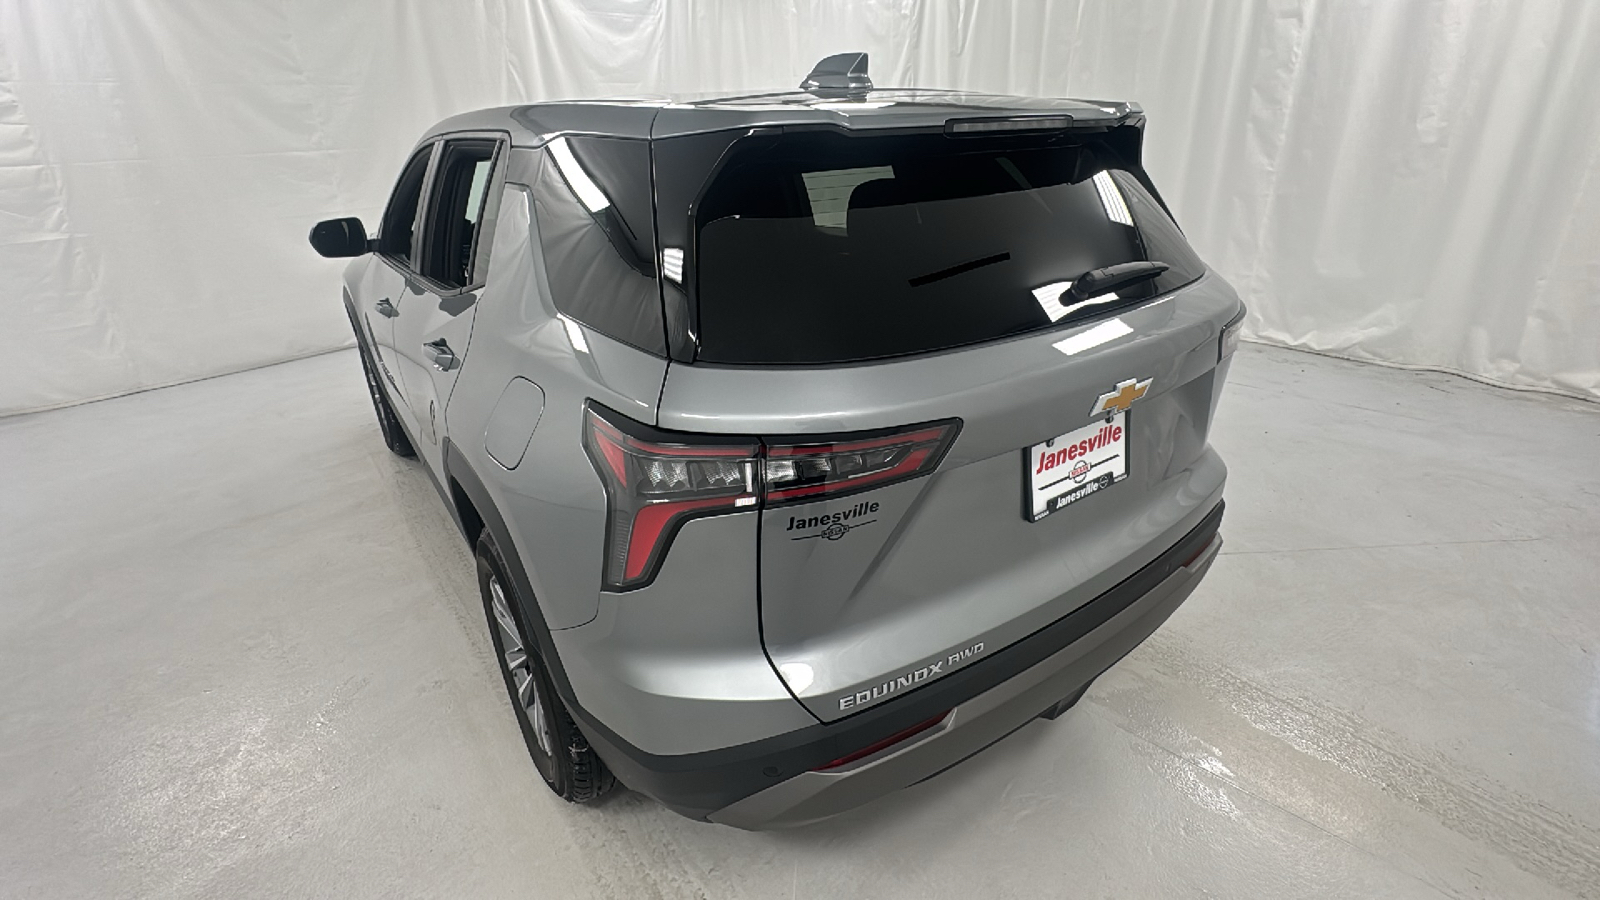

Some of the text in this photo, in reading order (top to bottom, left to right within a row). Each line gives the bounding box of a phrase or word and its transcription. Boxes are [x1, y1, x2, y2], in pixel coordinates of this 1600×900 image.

[1036, 425, 1122, 475] Janesville
[1056, 481, 1099, 509] Janesville
[786, 501, 880, 531] Janesville
[839, 642, 984, 711] EQUINOX AWD
